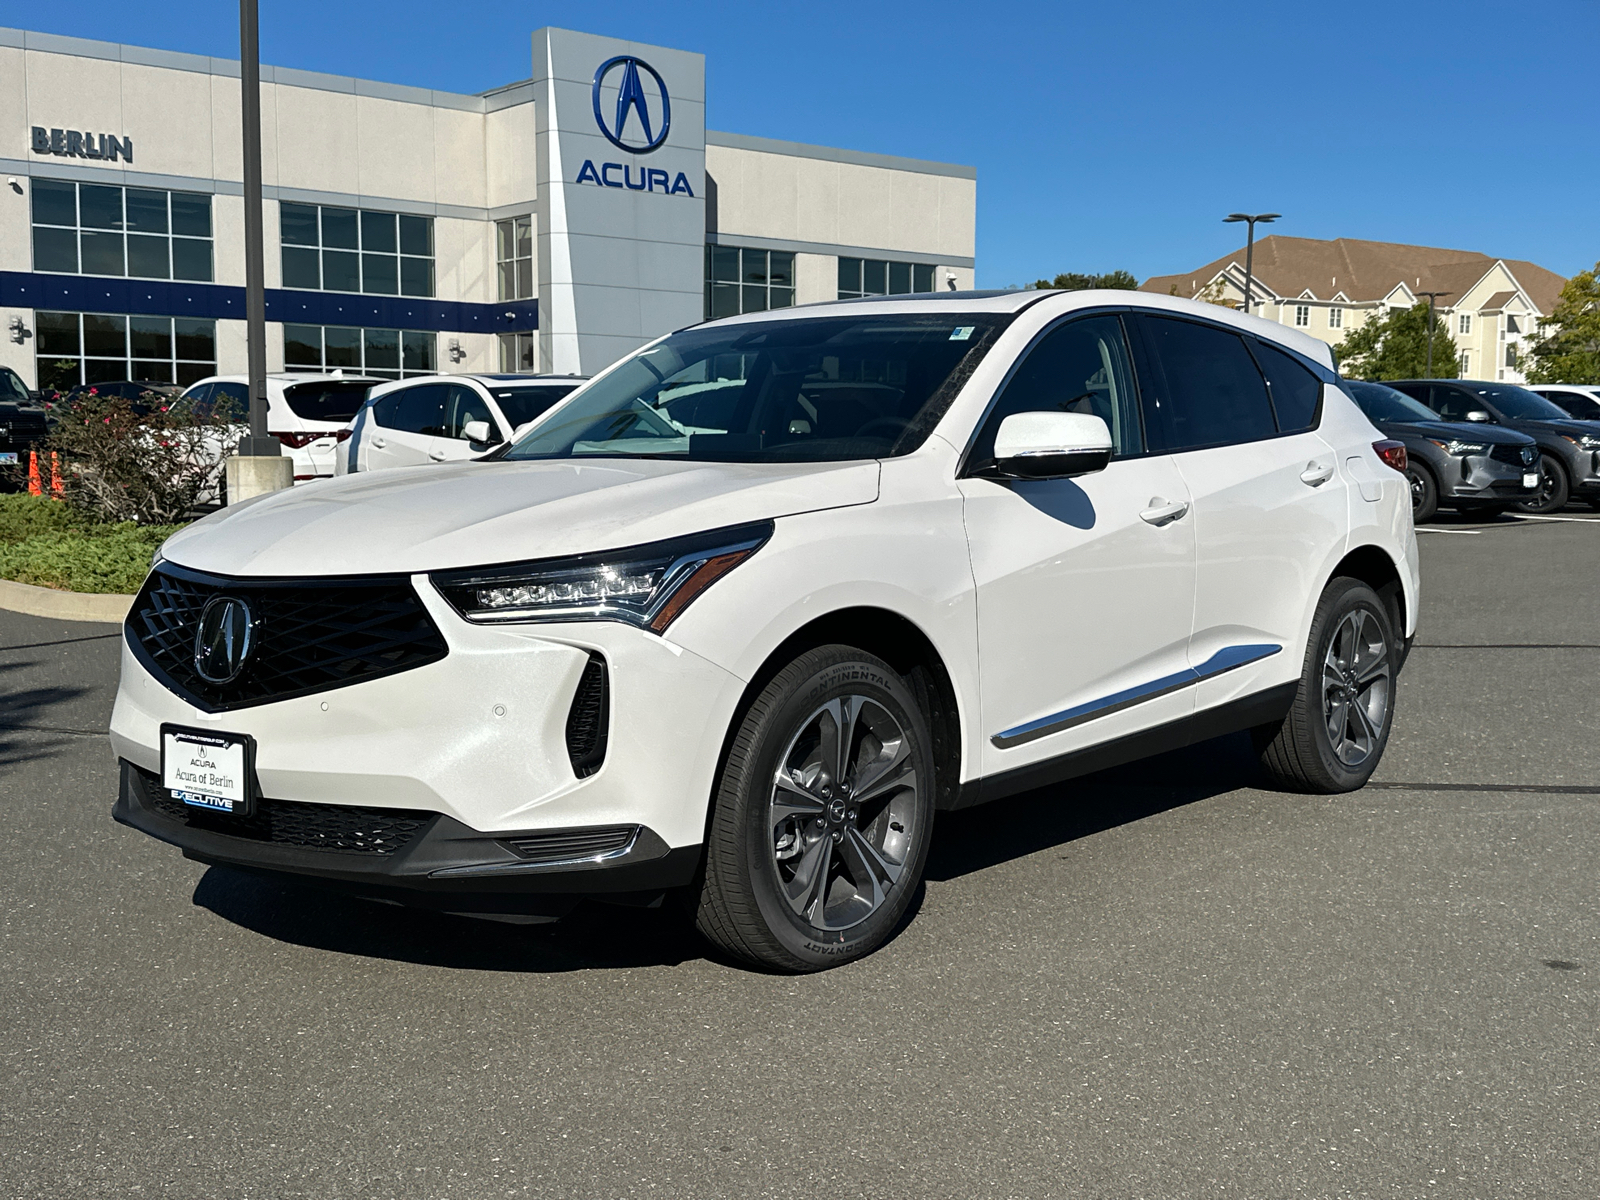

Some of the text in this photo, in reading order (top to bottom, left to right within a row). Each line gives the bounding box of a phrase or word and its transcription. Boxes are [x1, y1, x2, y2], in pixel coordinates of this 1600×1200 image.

[31, 126, 132, 162] BERLIN
[576, 159, 694, 197] ACURA
[800, 671, 892, 708] CONTINENTAL
[175, 767, 234, 788] Acura of Berlin
[190, 758, 217, 770] ACURA
[171, 789, 233, 808] EXECUTIVE
